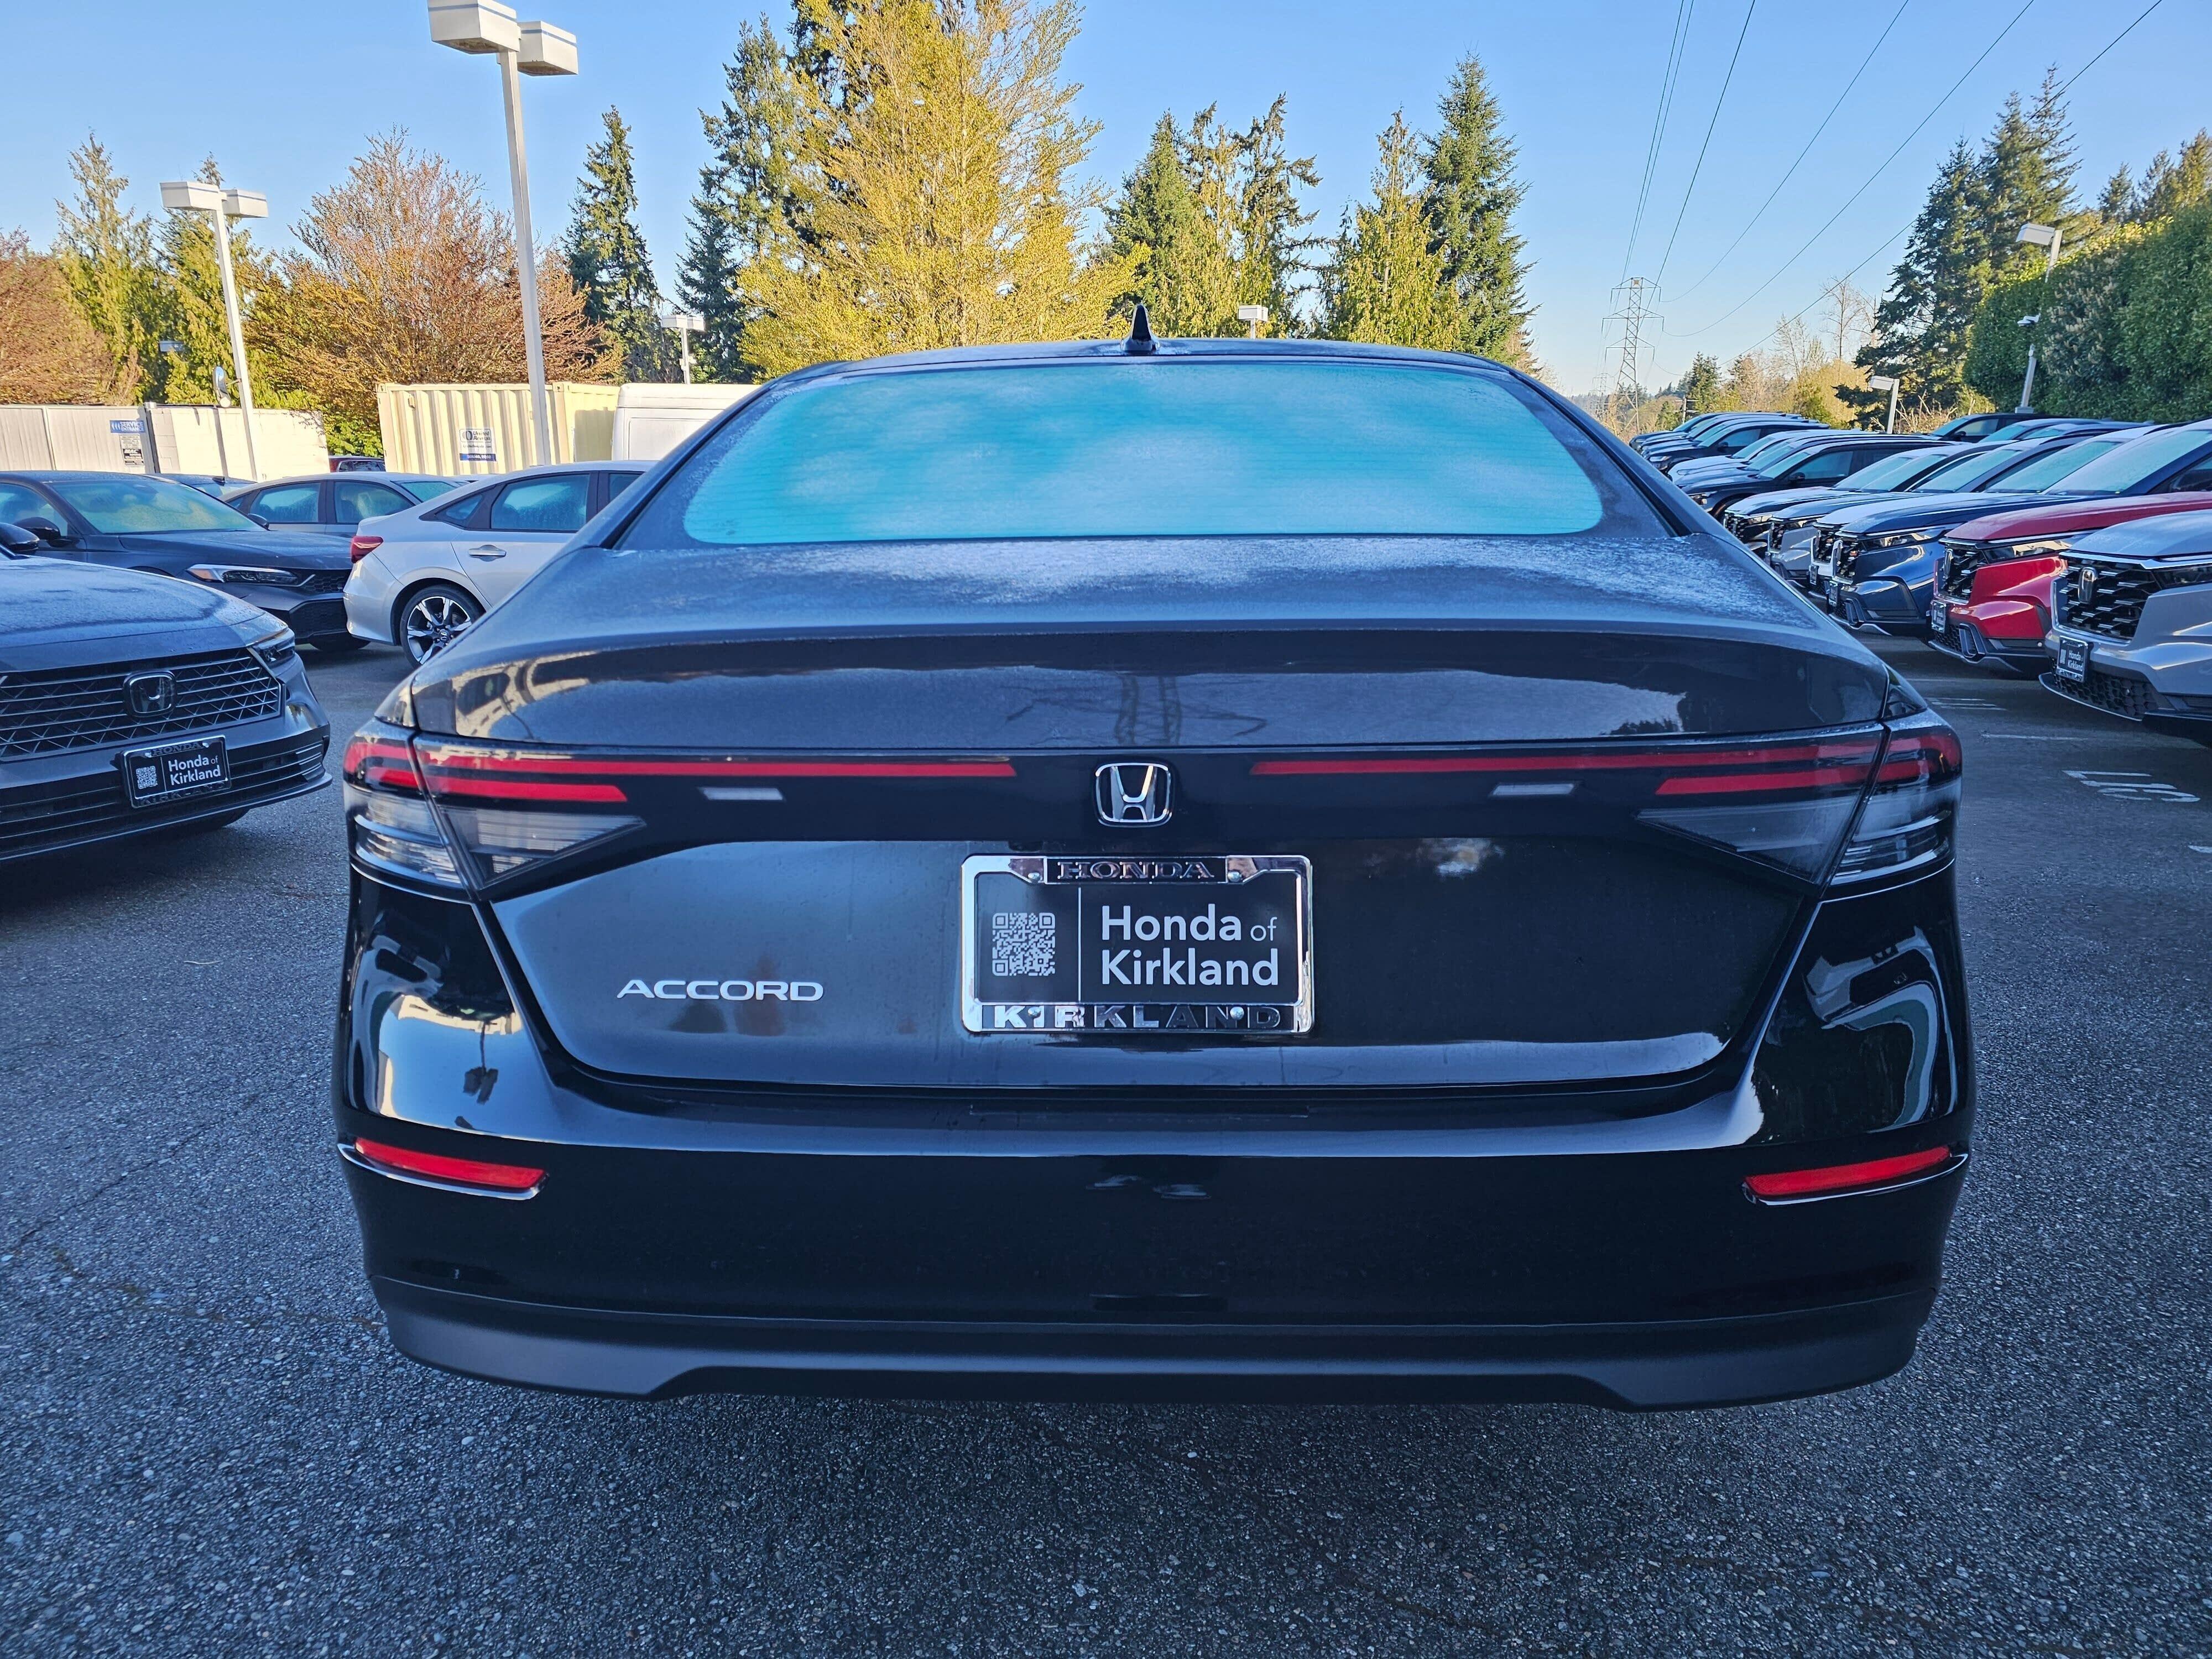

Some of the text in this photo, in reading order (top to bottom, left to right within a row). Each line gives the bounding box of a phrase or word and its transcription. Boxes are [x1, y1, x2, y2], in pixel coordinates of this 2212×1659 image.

[153, 742, 203, 756] HONDA
[168, 754, 218, 772] Honda of
[170, 765, 221, 785] Kirkland
[1057, 861, 1214, 880] HONDA
[1102, 903, 1277, 941] Honda of
[1102, 947, 1279, 986] Kirkland
[617, 979, 824, 1001] ACCORD
[994, 1005, 1281, 1029] KIRKLAND
